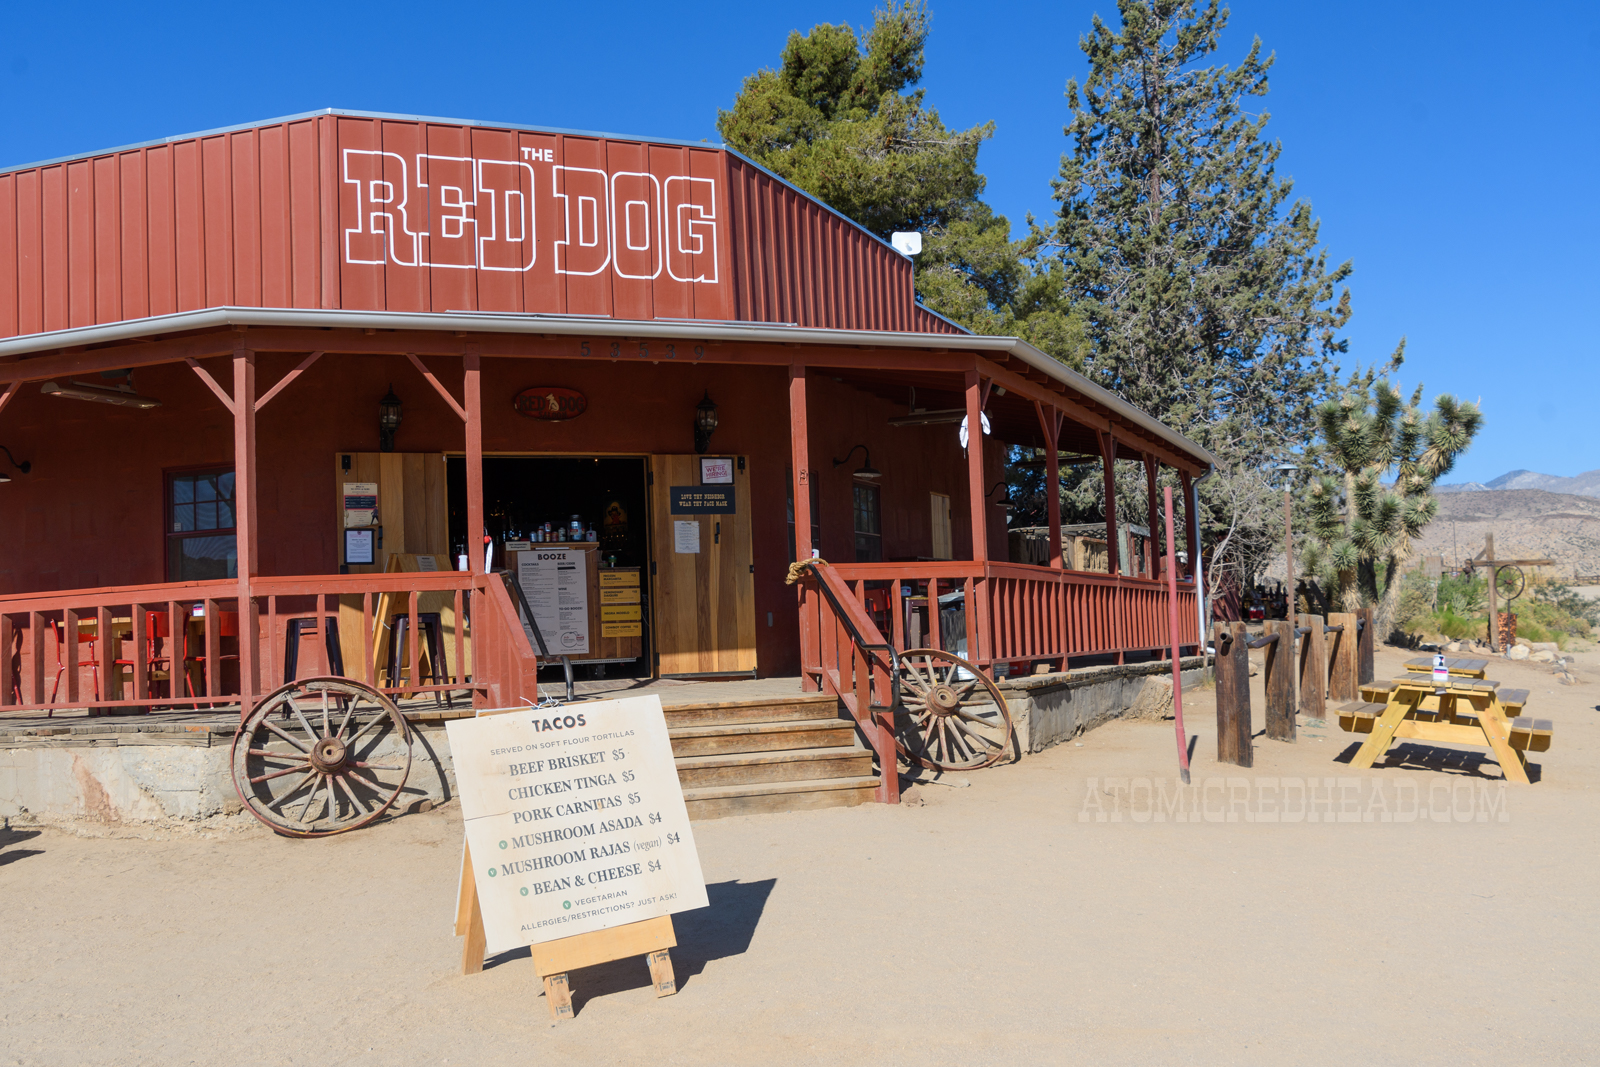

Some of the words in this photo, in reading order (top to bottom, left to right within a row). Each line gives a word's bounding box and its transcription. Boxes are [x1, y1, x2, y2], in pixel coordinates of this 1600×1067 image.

[521, 146, 554, 163] THE
[343, 148, 536, 272] RED
[553, 165, 719, 284] DOG
[580, 341, 705, 361] 53539
[519, 395, 546, 411] RED
[559, 396, 584, 412] DOG
[532, 714, 587, 733] TACOS
[490, 746, 523, 756] SERVED
[540, 740, 561, 749] SOFT
[563, 736, 590, 746] FLOUR
[592, 730, 635, 741] TORTILLAS
[509, 761, 544, 776] BEEF
[548, 751, 606, 771] BRISKET
[612, 748, 626, 762] $5
[508, 780, 572, 801] CHICKEN
[574, 773, 617, 790] TINGA
[622, 770, 636, 783] $5
[513, 806, 554, 824] PORK
[556, 795, 623, 817] CARNITAS
[628, 792, 641, 805] $5
[511, 823, 596, 850] MUSHROOM
[599, 815, 643, 833] ASADA
[649, 812, 662, 825] $4
[501, 849, 587, 876] MUSHROOM
[589, 841, 631, 860] RAJAS
[633, 836, 662, 853] (vegan)
[667, 832, 680, 845] $4
[533, 877, 572, 896] BEAN
[574, 874, 586, 887] &
[588, 863, 643, 884] CHEESE
[648, 859, 662, 873] $4
[520, 902, 635, 932] ALLERGIES/RESTRICTIONS?
[638, 897, 657, 908] JUST
[659, 892, 677, 902] ASK!
[574, 890, 628, 906] VEGETARIAN
